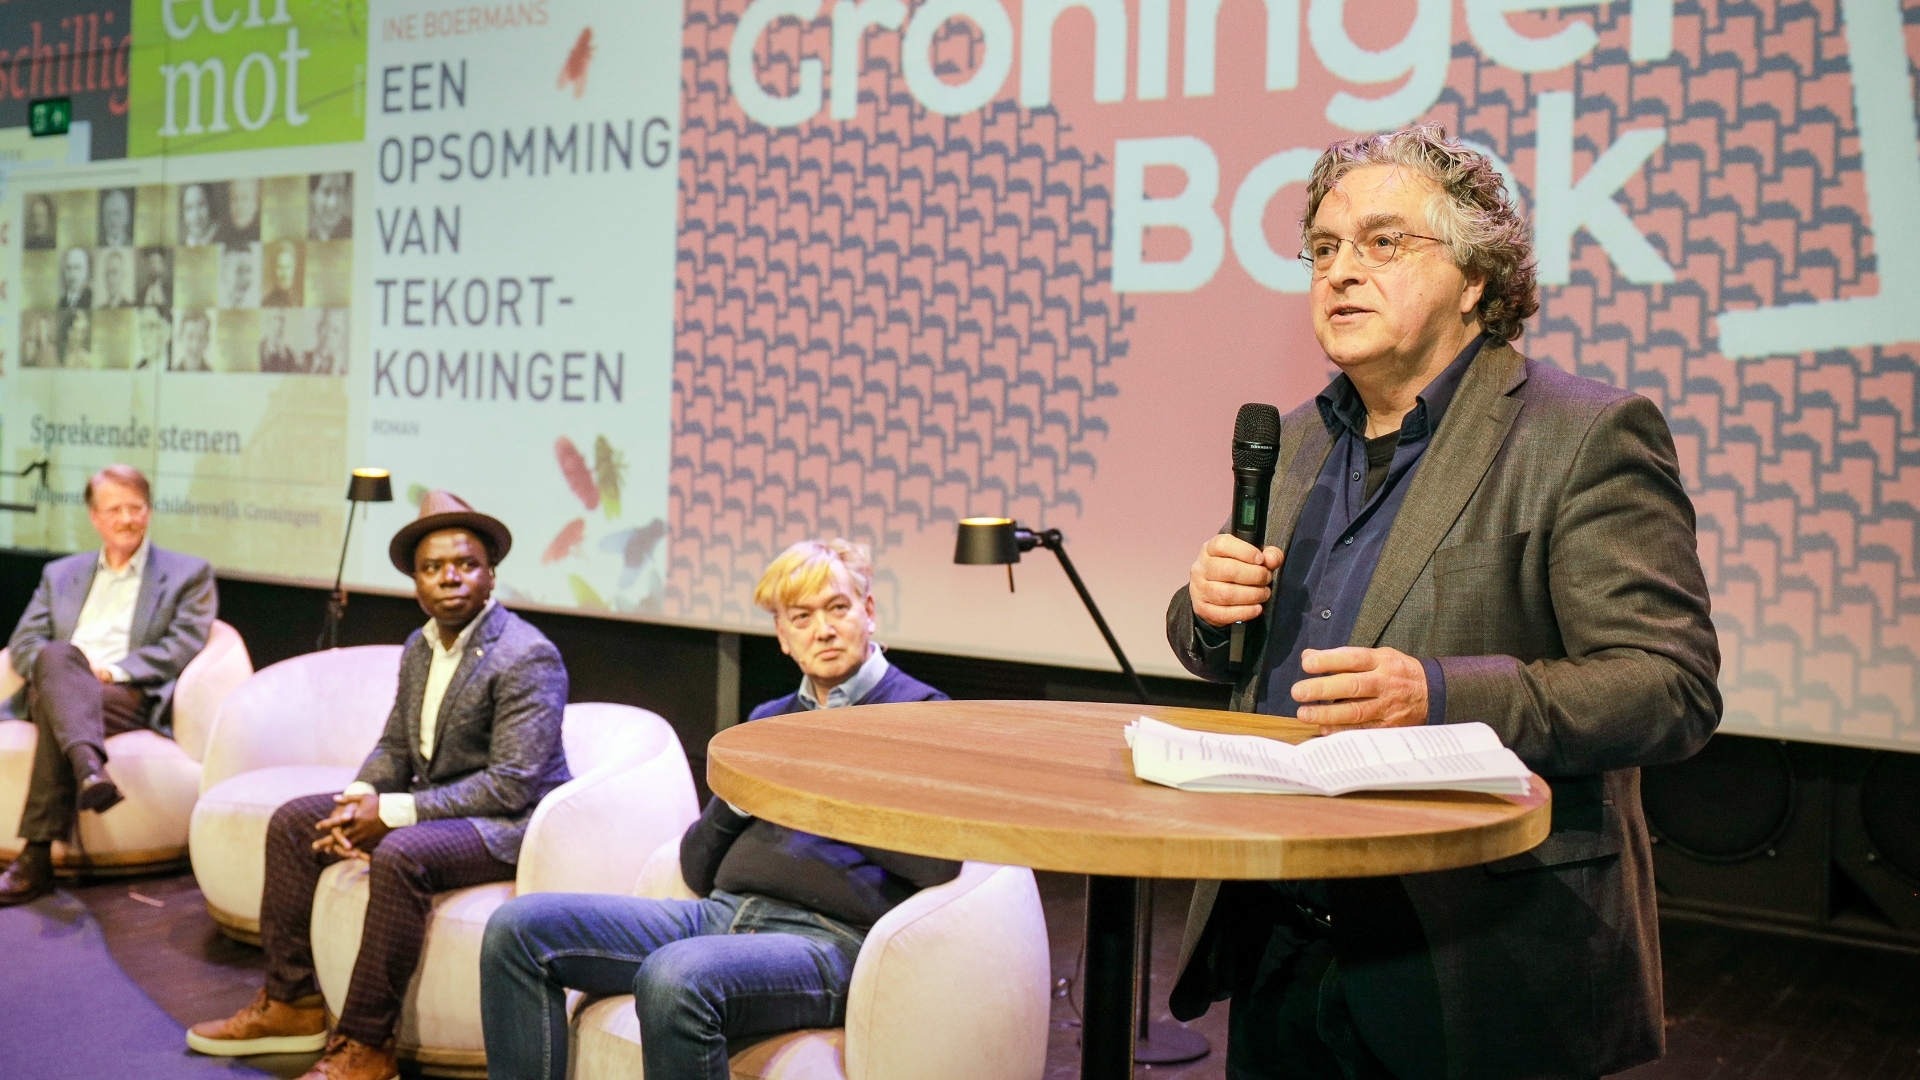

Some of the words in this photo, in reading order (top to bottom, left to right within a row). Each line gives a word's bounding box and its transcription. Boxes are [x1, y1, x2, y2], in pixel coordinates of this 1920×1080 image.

[382, 13, 418, 42] INE
[423, 0, 549, 39] BOERMANS
[157, 27, 311, 137] mot
[382, 59, 467, 113] EEN
[379, 116, 671, 184] OPSOMMING
[1112, 91, 1676, 293] Bok
[376, 205, 461, 254] VAN
[375, 277, 573, 327] TEKORT-
[374, 350, 624, 403] KOMINGEN
[30, 415, 150, 455] Sprekende
[158, 424, 240, 454] stenen
